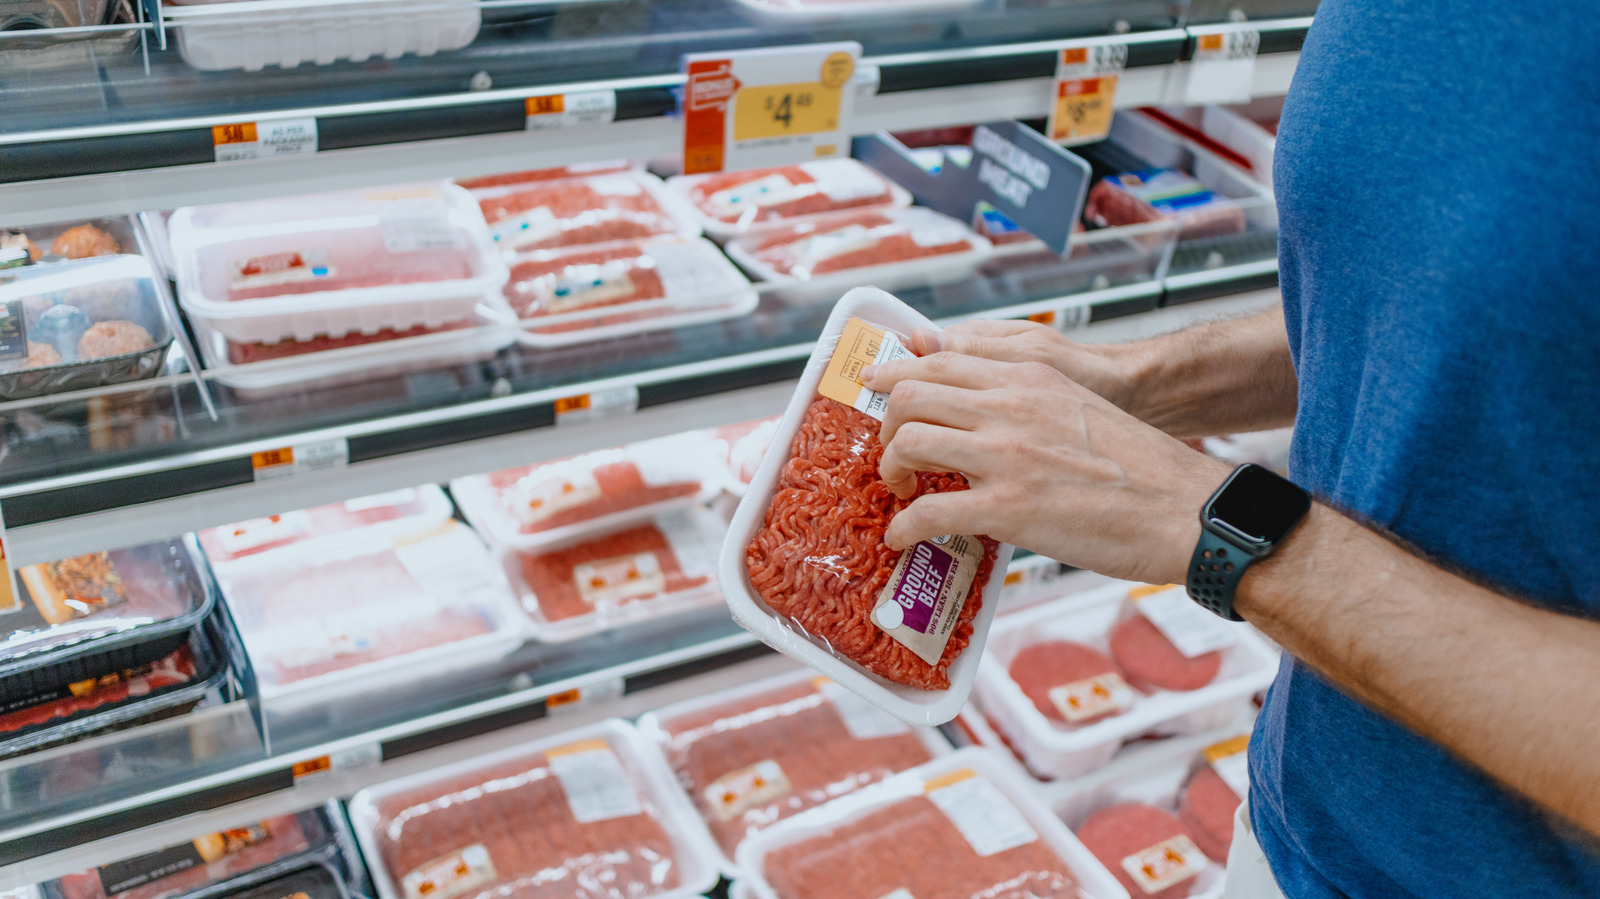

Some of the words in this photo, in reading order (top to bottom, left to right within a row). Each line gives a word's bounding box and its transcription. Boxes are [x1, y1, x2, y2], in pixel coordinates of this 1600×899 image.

[972, 125, 1051, 190] GROUND
[892, 576, 900, 591] ALL
[899, 544, 914, 577] NATURAL
[897, 544, 932, 610] GROUND
[918, 565, 942, 608] BEEF
[928, 618, 938, 635] 90%
[935, 594, 948, 618] LEAN
[945, 573, 954, 590] 10%
[951, 558, 960, 575] FAT
